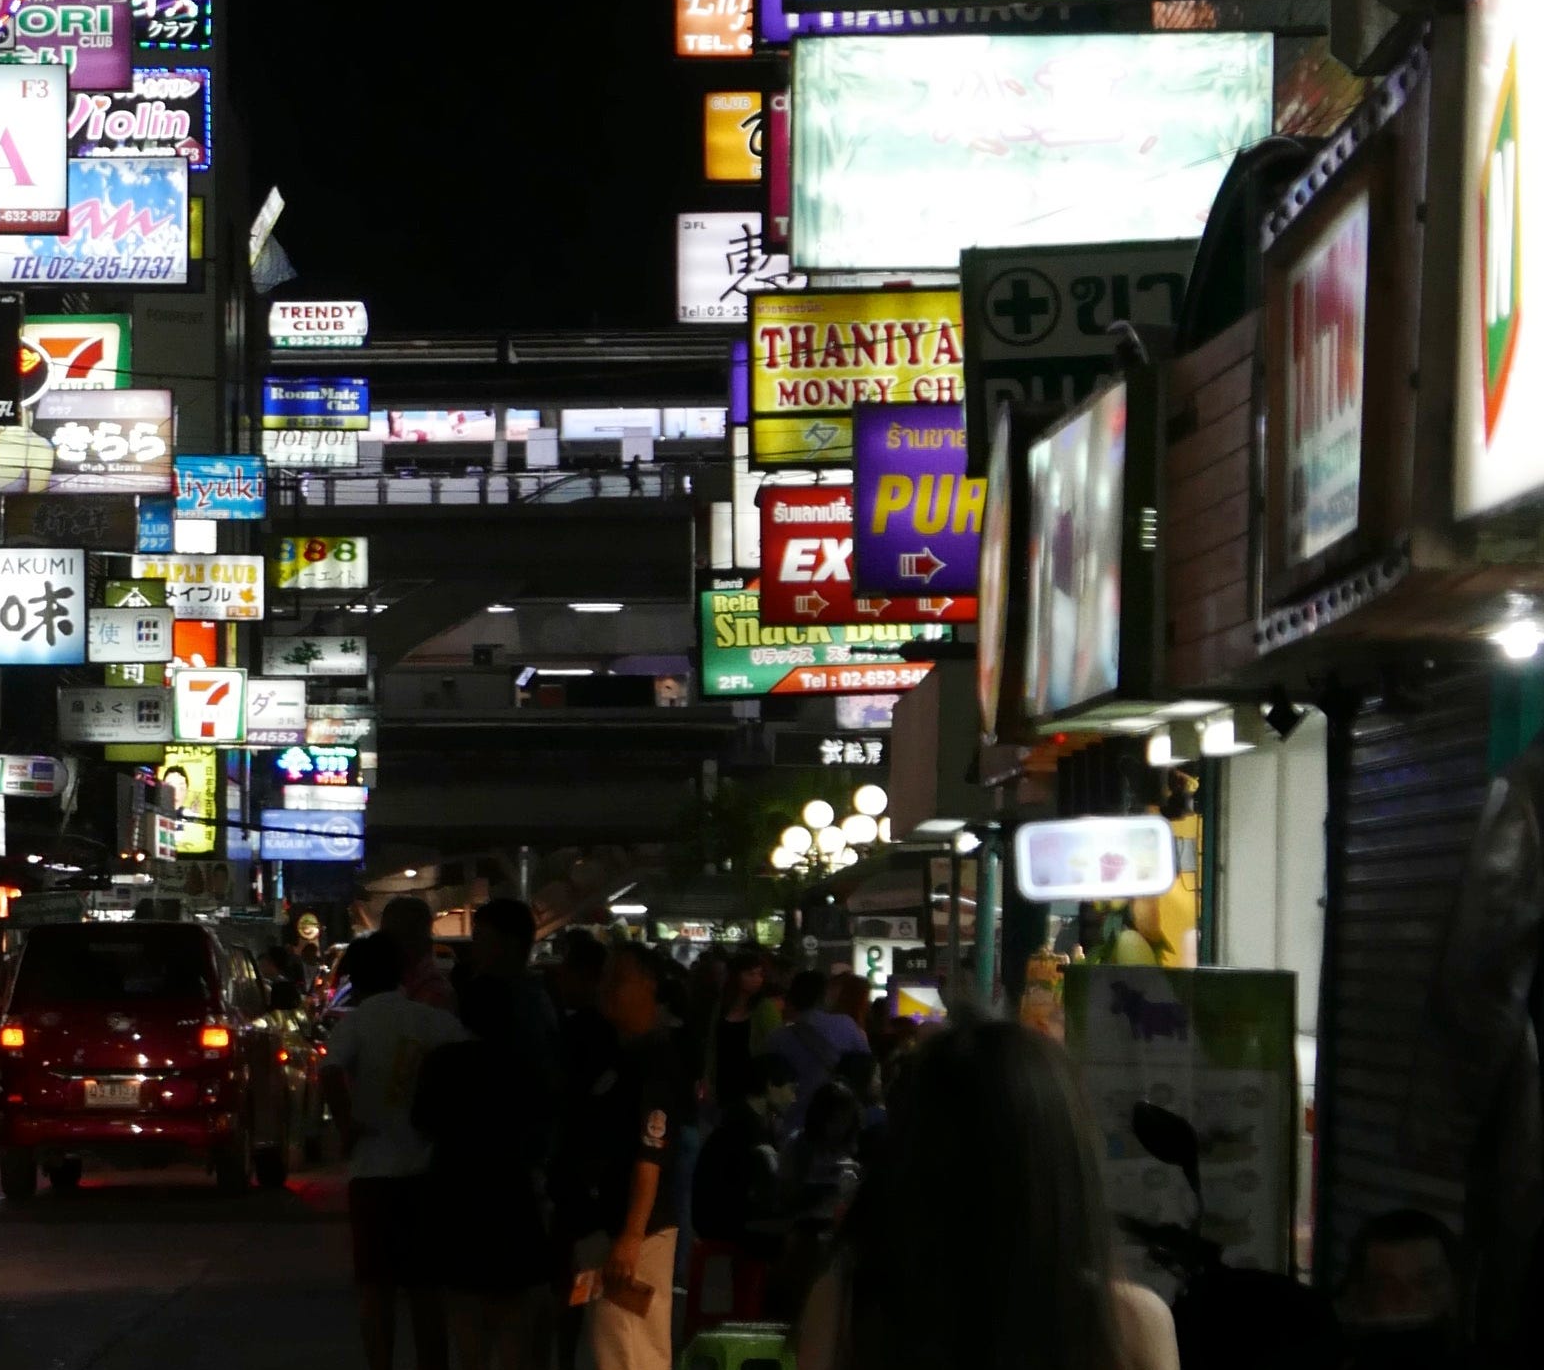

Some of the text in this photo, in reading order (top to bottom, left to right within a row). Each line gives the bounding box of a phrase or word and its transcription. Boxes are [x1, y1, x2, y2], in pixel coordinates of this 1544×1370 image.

[14, 4, 114, 37] ORI
[148, 20, 198, 40] クラブ
[78, 36, 114, 49] CLUB
[683, 33, 734, 52] TEL.
[21, 79, 49, 99] F3
[711, 96, 752, 110] CLUB
[10, 256, 44, 278] TEL
[46, 255, 176, 278] 02-235-7737
[279, 306, 358, 319] TRENDY
[293, 320, 345, 331] CLUB
[759, 320, 964, 370] THANIYA
[270, 386, 361, 401] RoomMate
[776, 378, 895, 407] MONEY
[326, 400, 361, 412] Club
[52, 422, 167, 462] きらら
[79, 462, 143, 473] Club Kirara
[142, 562, 258, 585] MAPLE CLUB
[166, 586, 232, 603] メイプル
[712, 594, 760, 614] Rela
